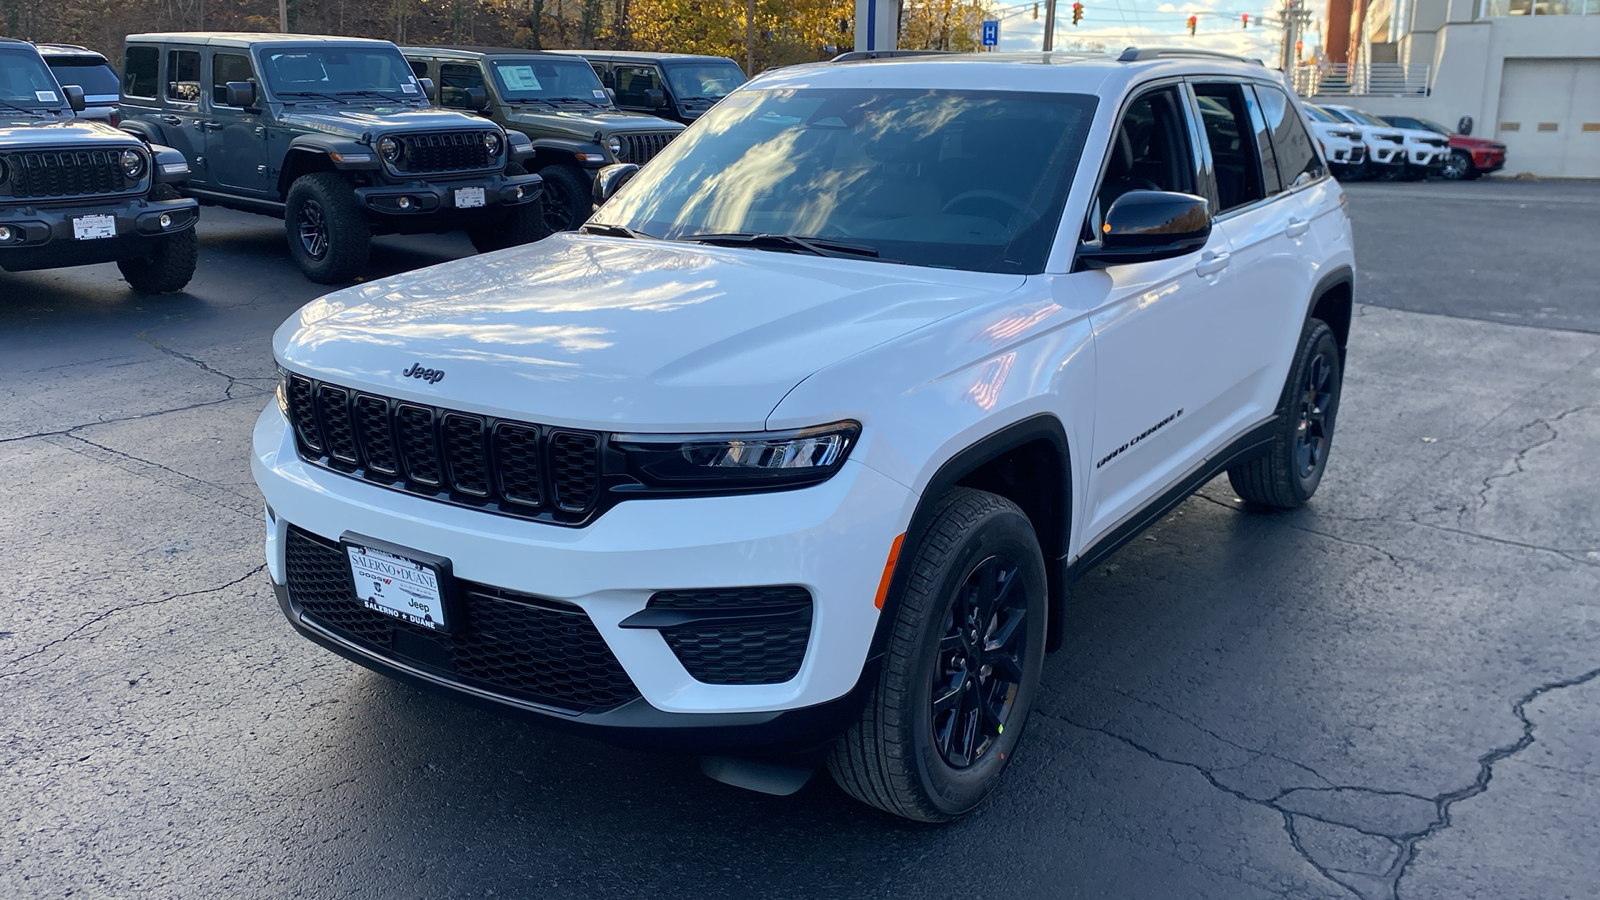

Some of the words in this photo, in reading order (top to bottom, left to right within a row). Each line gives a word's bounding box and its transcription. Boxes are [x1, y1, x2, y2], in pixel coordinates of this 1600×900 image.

[986, 26, 995, 39] H
[402, 362, 445, 385] Jeep
[1096, 443, 1129, 469] GRAND
[1130, 412, 1176, 446] CHEROKEE
[351, 555, 396, 576] SALERNO
[400, 568, 437, 589] DUANE
[364, 601, 399, 618] SALERNO
[409, 614, 436, 630] DUANE
[408, 598, 430, 613] Jeep
